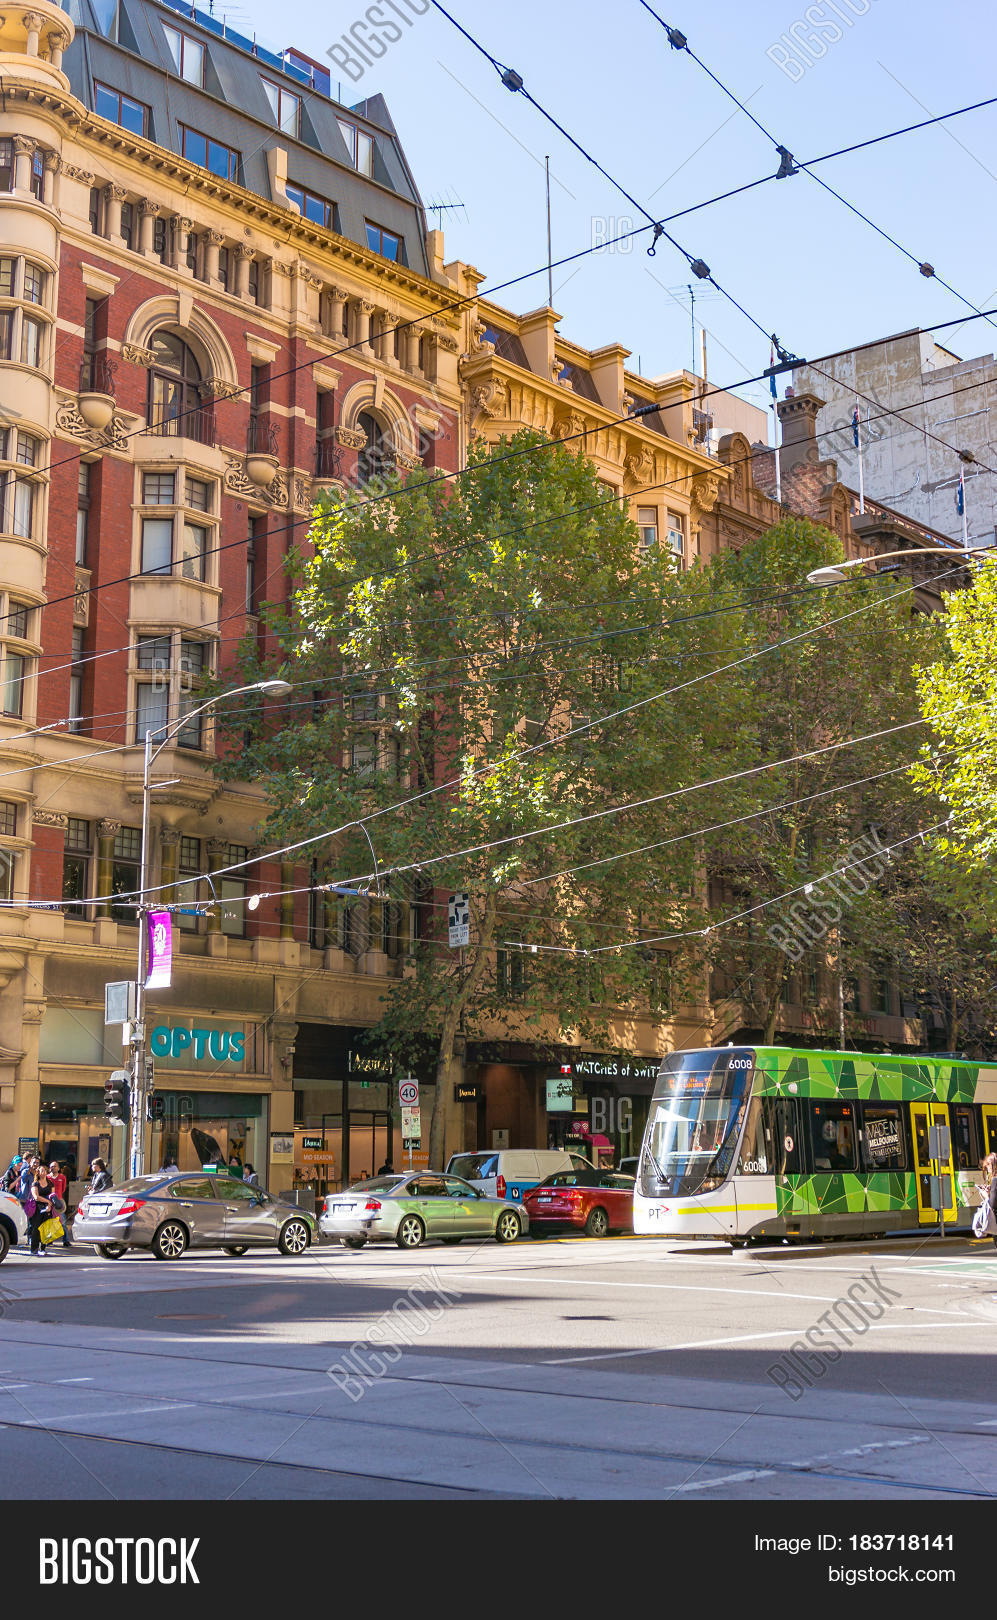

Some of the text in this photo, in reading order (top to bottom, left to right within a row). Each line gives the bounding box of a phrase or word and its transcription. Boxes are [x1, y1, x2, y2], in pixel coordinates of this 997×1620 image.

[151, 1025, 246, 1062] OPTUS
[575, 1061, 618, 1076] WATCHES
[621, 1064, 631, 1077] of
[728, 1059, 753, 1070] 6008
[401, 1088, 416, 1098] 40
[869, 1133, 899, 1148] MELBOURNE
[301, 1167, 335, 1180] SALE
